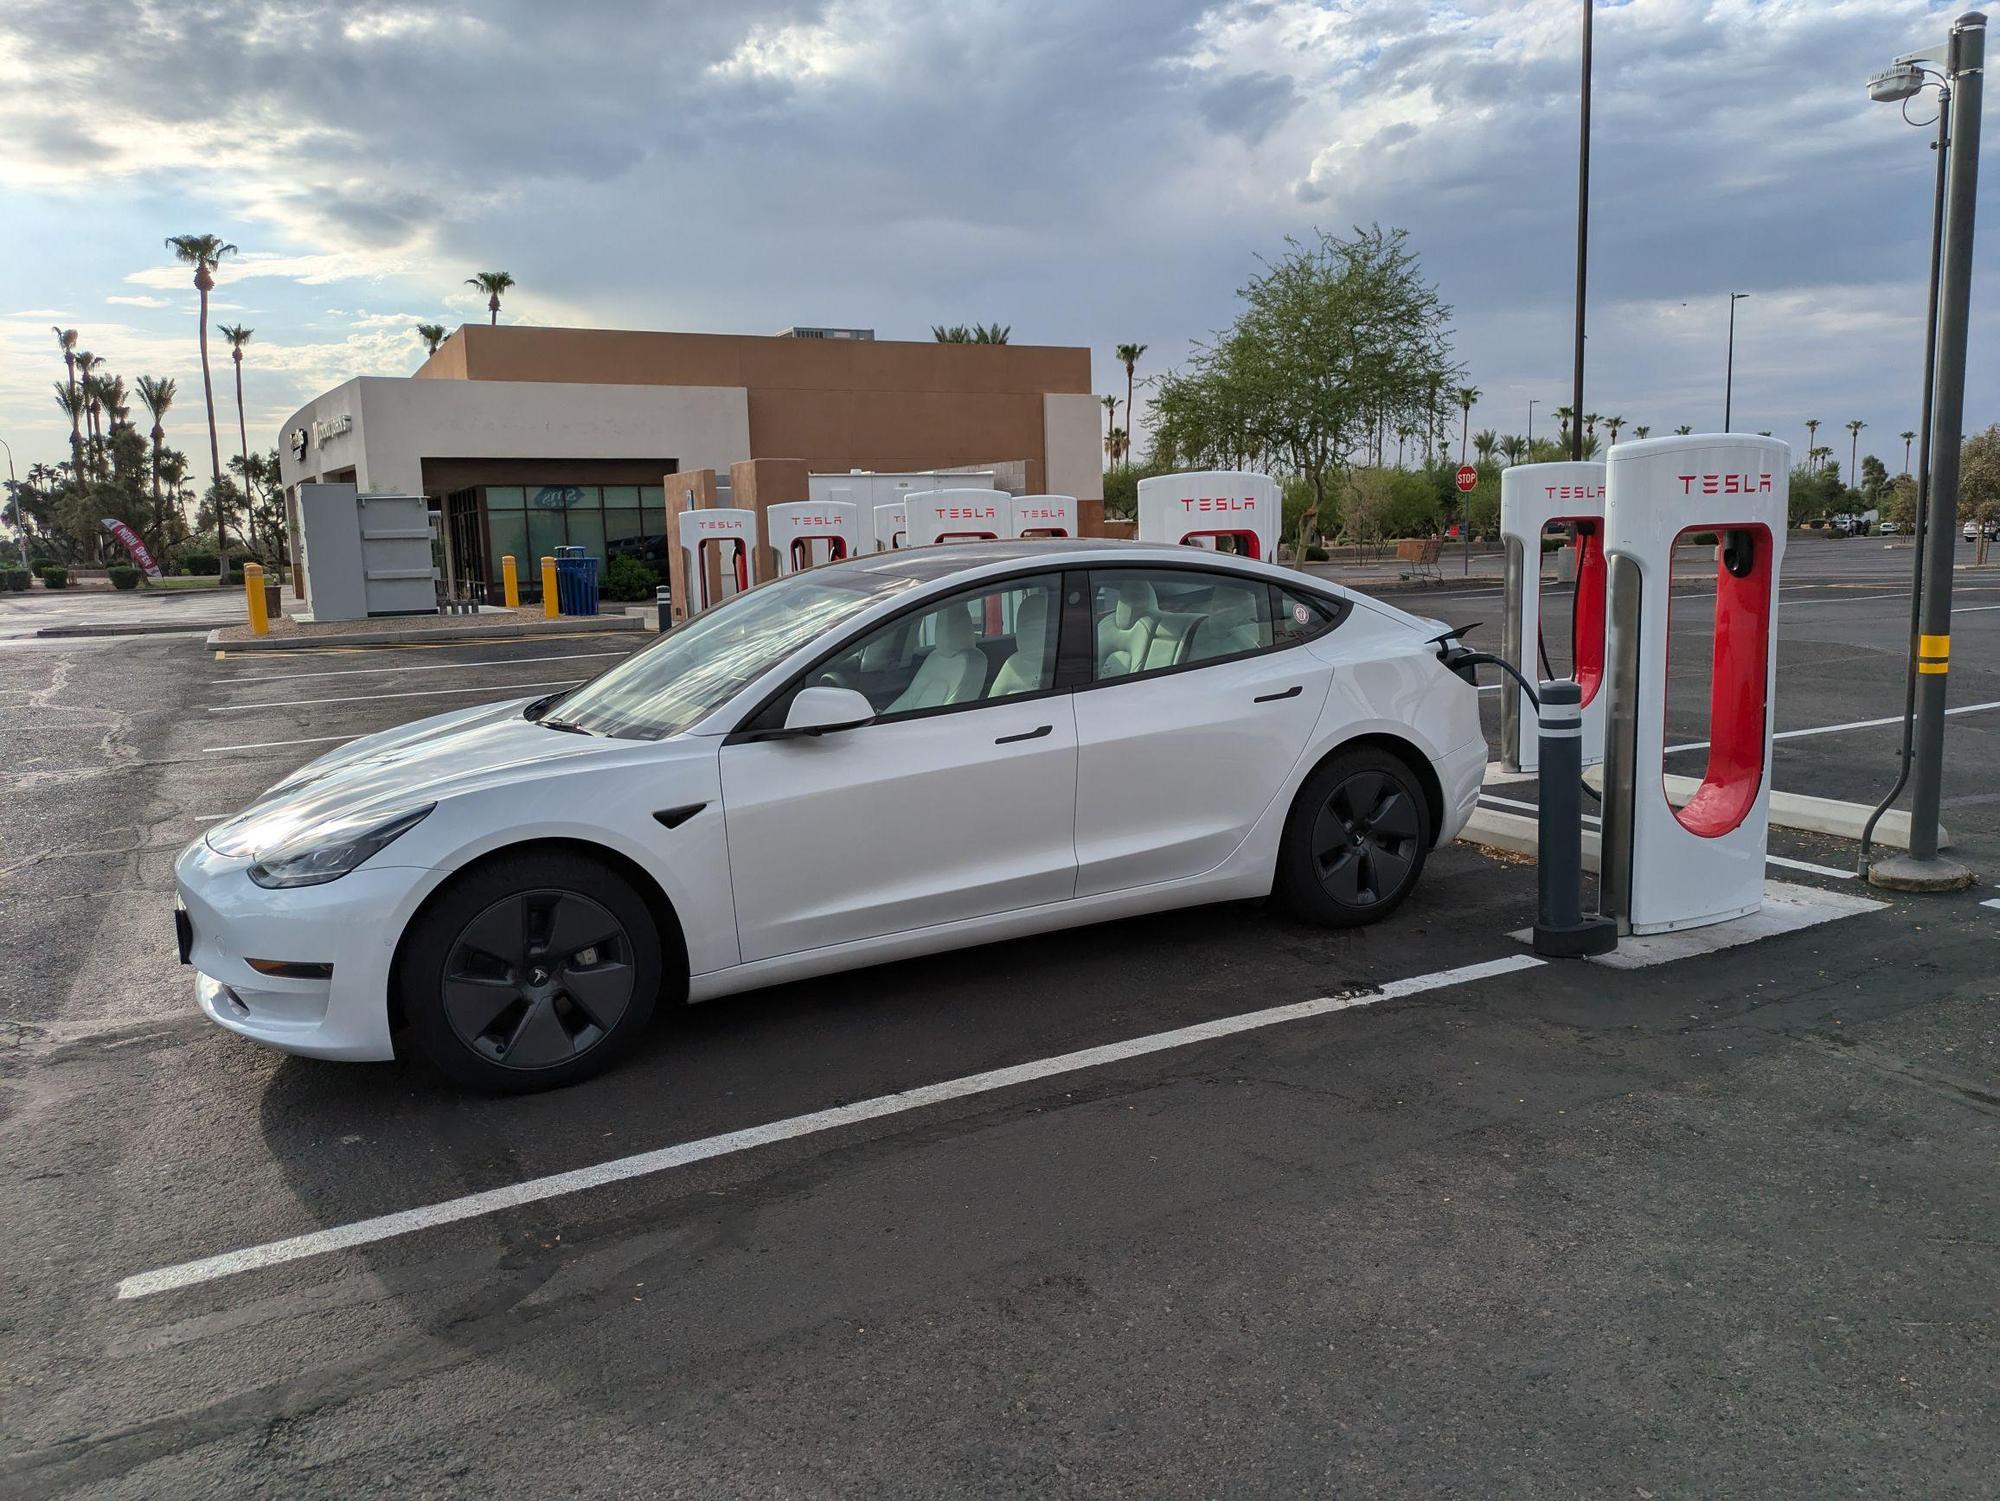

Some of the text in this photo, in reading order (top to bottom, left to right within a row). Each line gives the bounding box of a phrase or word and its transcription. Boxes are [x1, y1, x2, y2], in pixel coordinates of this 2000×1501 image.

[1457, 473, 1476, 484] STOP
[1678, 473, 1772, 494] TESLA
[1545, 486, 1605, 498] TESLA
[1180, 496, 1255, 512] TESLA
[935, 507, 995, 518] TESLA
[1021, 509, 1065, 518] TESLA
[699, 521, 743, 529] TESLA
[792, 516, 842, 526] TESLA
[117, 527, 153, 567] NOW OPEN
